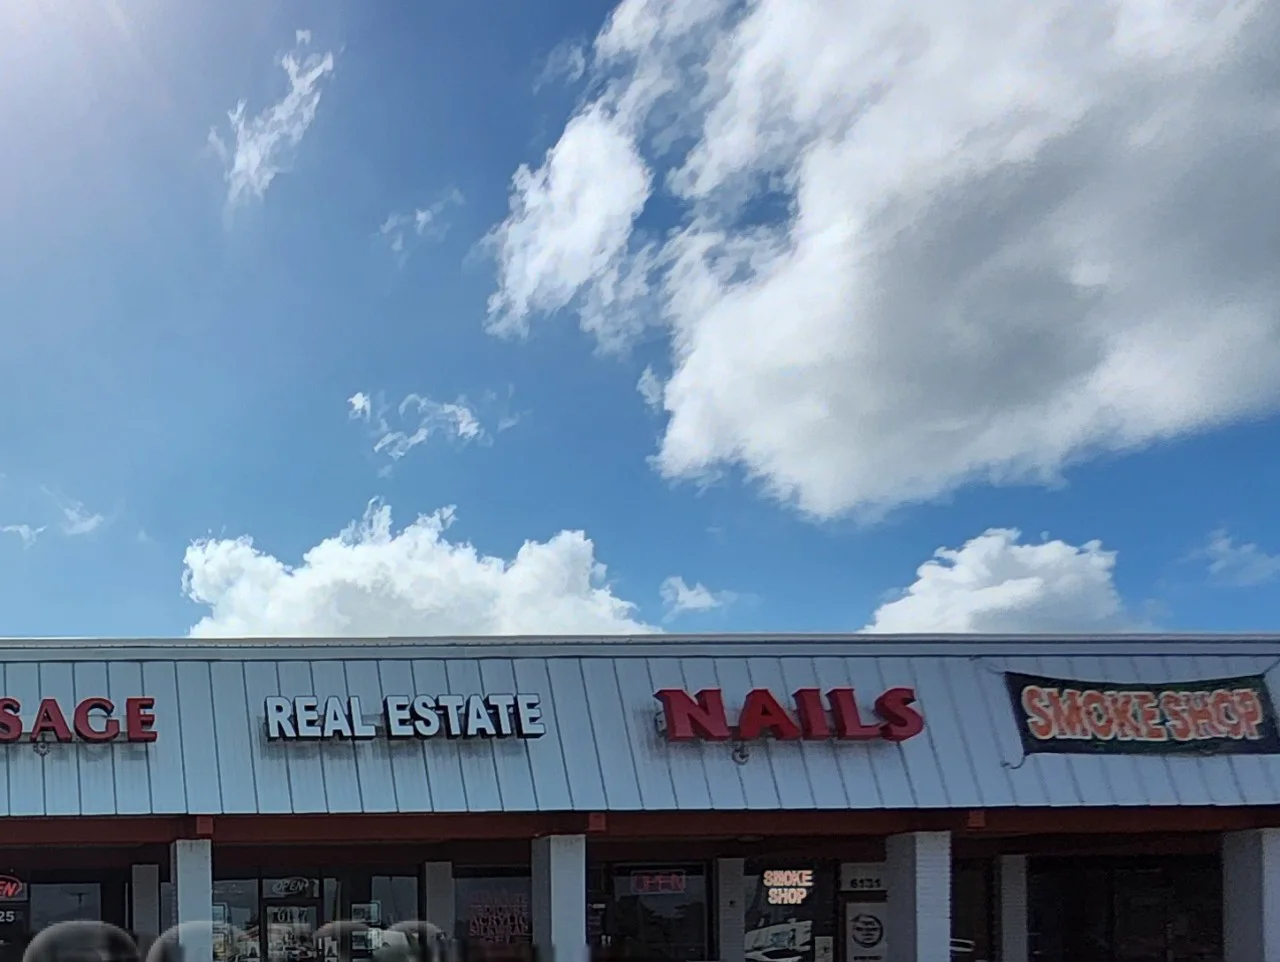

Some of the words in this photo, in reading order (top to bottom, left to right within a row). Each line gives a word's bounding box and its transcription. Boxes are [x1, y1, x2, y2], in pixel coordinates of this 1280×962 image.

[265, 695, 377, 741] REAL
[380, 693, 547, 741] ESTATE
[653, 687, 924, 742] NAILS
[1022, 685, 1168, 741] SMOKE
[1158, 688, 1263, 741] SHOP
[275, 878, 305, 892] OPEN
[763, 870, 814, 886] SMOKE
[767, 888, 807, 904] SHOP
